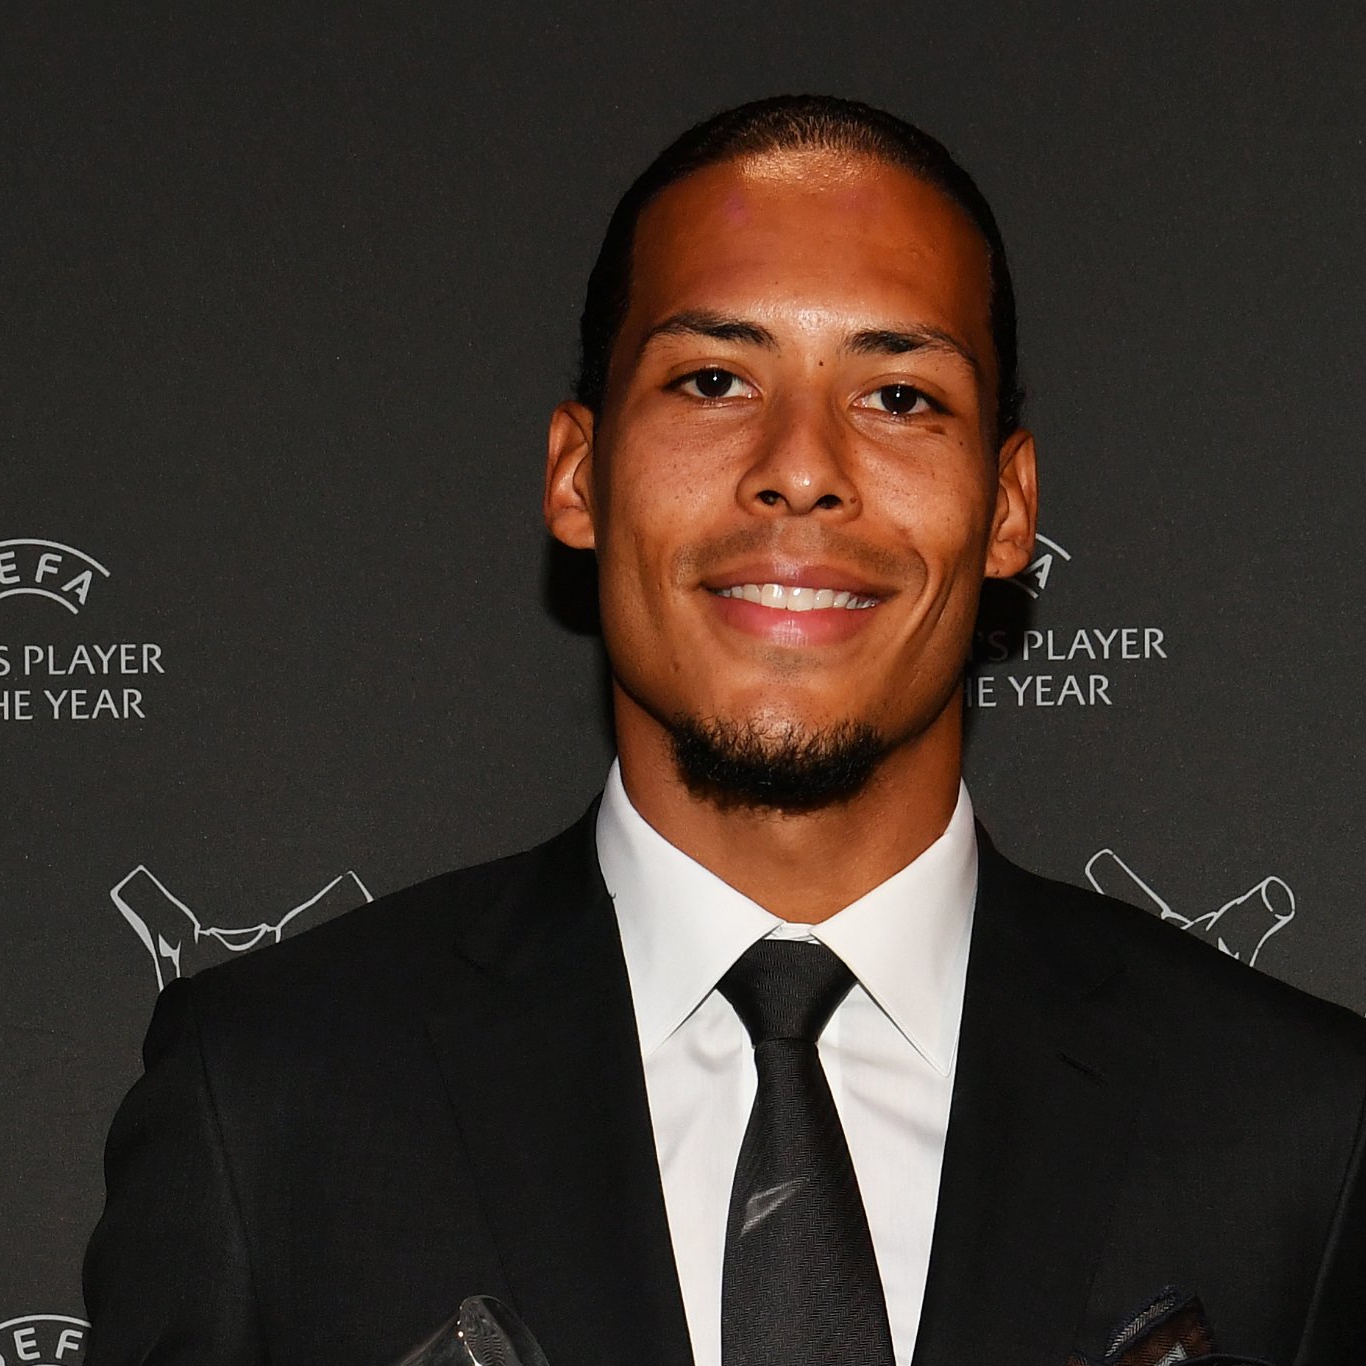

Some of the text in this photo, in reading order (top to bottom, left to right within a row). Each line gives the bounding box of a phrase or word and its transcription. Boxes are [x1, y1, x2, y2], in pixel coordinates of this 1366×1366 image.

[25, 644, 164, 675] PLAYER
[1023, 628, 1168, 661] PLAYER
[44, 689, 145, 719] YEAR
[1008, 675, 1113, 707] YEAR
